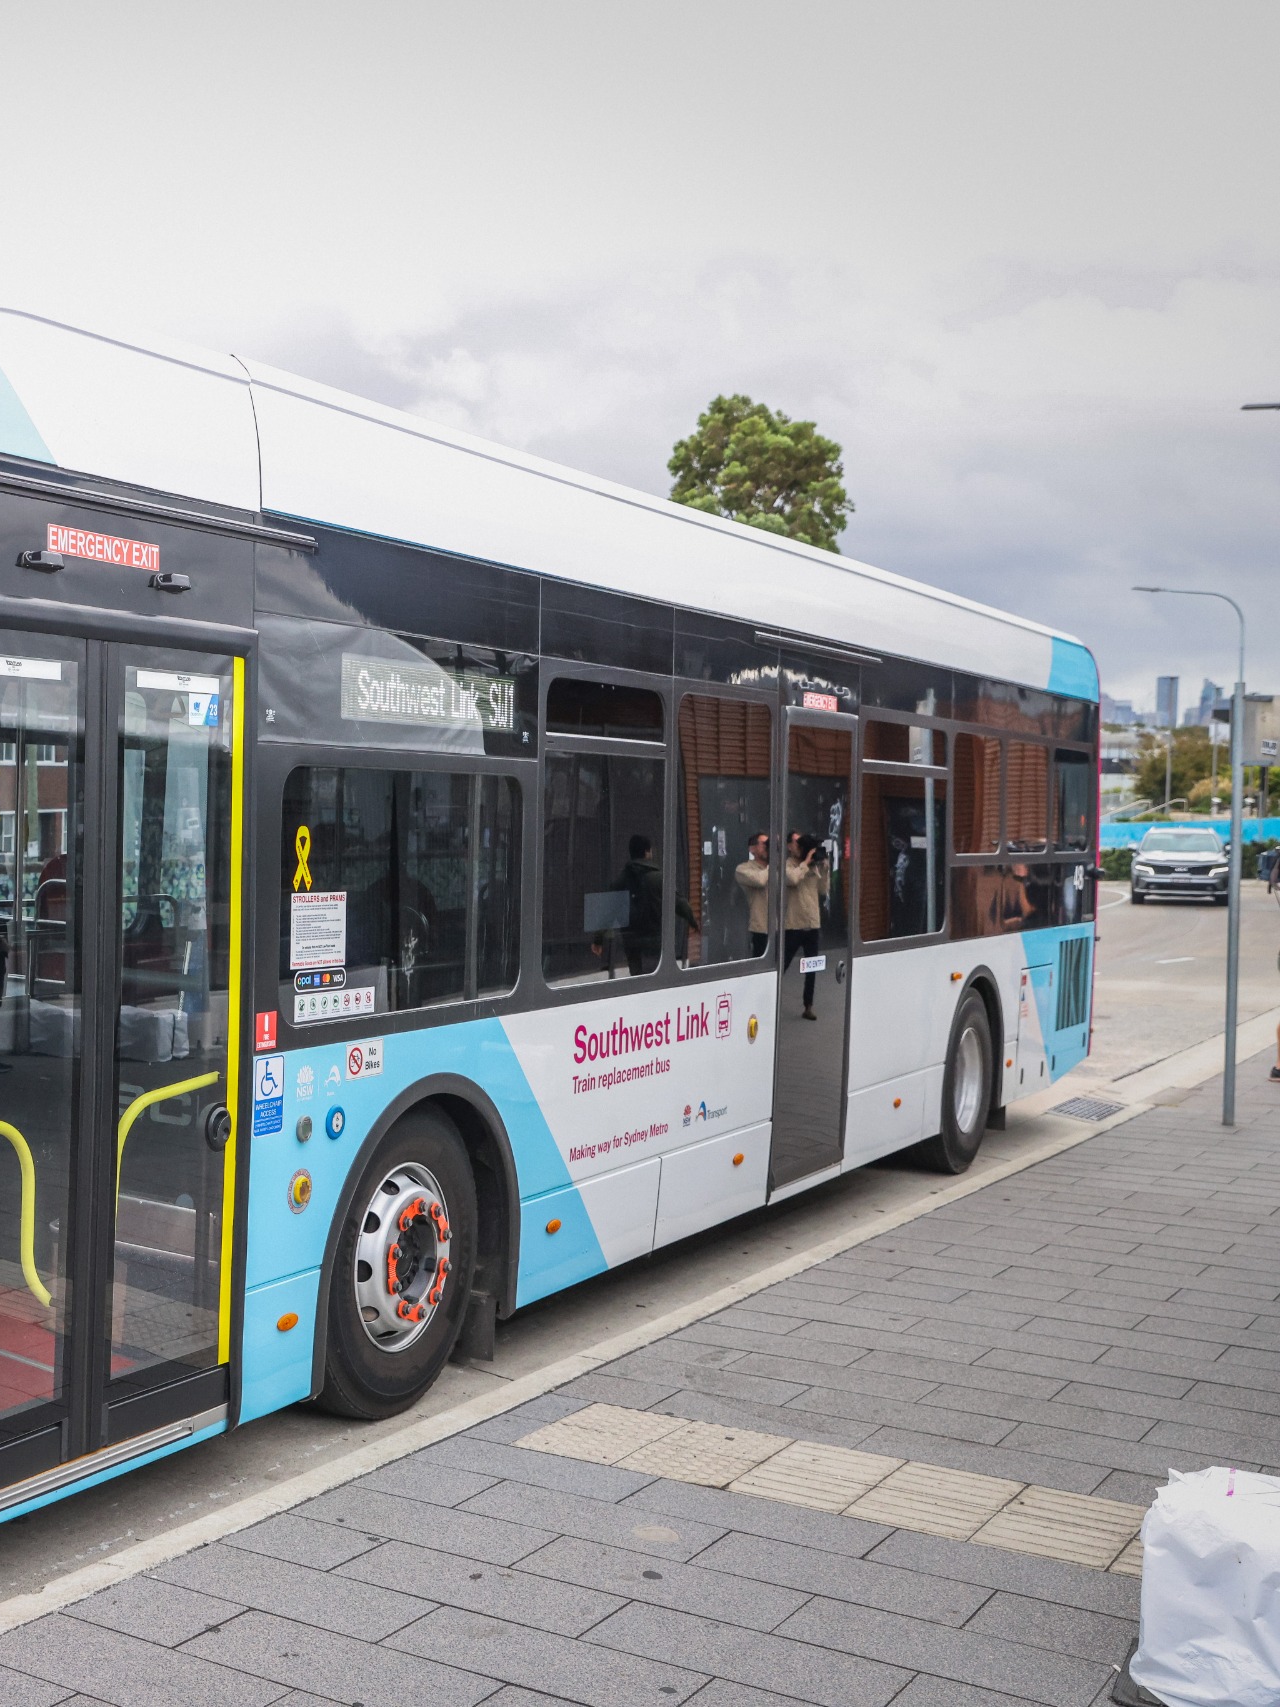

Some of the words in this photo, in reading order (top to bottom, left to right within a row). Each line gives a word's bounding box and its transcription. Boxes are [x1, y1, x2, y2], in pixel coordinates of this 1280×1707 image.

[49, 526, 129, 563] EMERGENCY
[132, 543, 159, 568] EXIT
[357, 670, 445, 717] Southwest
[451, 680, 479, 720] Link
[209, 704, 218, 716] 23
[297, 975, 311, 987] opal
[333, 974, 343, 982] VISA
[574, 1012, 671, 1064] Southwest
[676, 1002, 709, 1042] Link
[368, 1047, 376, 1056] No
[365, 1060, 380, 1070] Bikes
[573, 1073, 595, 1094] Train
[598, 1060, 654, 1090] replacement
[656, 1057, 670, 1074] bus
[296, 1084, 314, 1098] NSW
[255, 1100, 282, 1110] WHEELCHAIR
[260, 1109, 276, 1117] ACCESS
[707, 1105, 727, 1120] Transport
[569, 1145, 595, 1162] Making
[598, 1140, 610, 1153] way
[613, 1135, 622, 1148] for
[624, 1129, 648, 1146] Sydney
[650, 1123, 668, 1138] Metro
